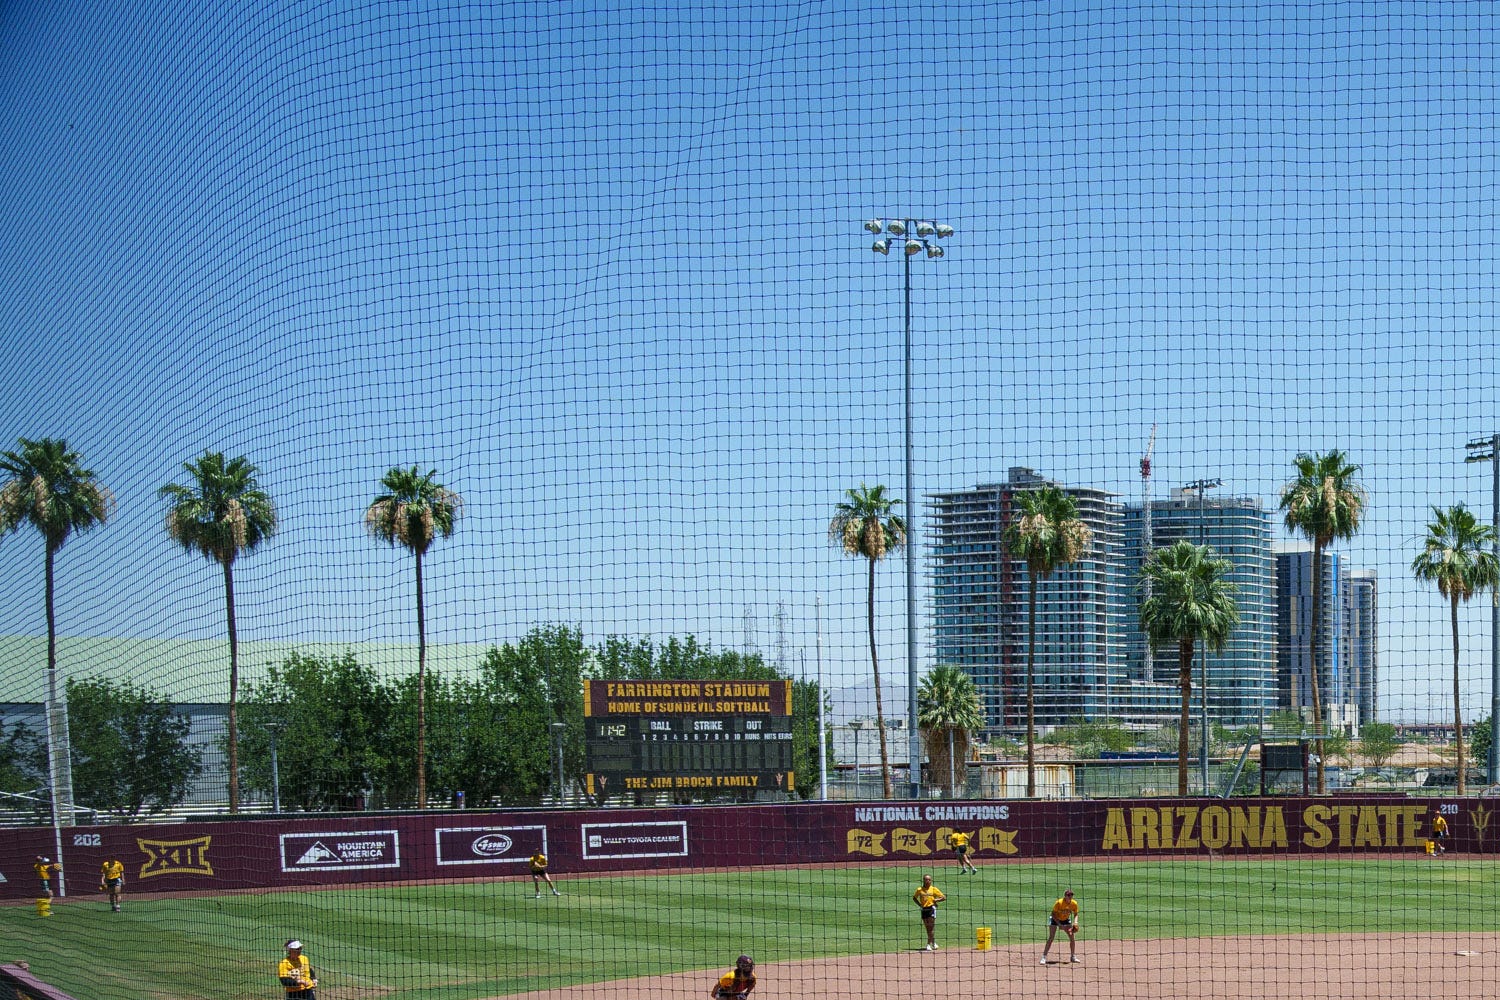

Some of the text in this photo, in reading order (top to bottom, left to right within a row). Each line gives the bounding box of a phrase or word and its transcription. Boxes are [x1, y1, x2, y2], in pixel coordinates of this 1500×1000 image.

[607, 683, 770, 697] FARRINGTON STADIUM
[608, 702, 770, 713] HOME OF SUN DEVIL SOFTBALL
[650, 720, 763, 731] BALL STRIKE OUT
[734, 733, 741, 741] 10
[625, 775, 759, 789] THE JIM BROCK FAMILY
[855, 806, 1009, 822] NATIONAL CHAMPIONS
[1440, 804, 1459, 814] 210
[1102, 804, 1429, 850] ARIZONA STATE
[73, 834, 101, 846] 202
[337, 841, 386, 851] MOUNTAIN
[342, 849, 384, 858] AMERICA
